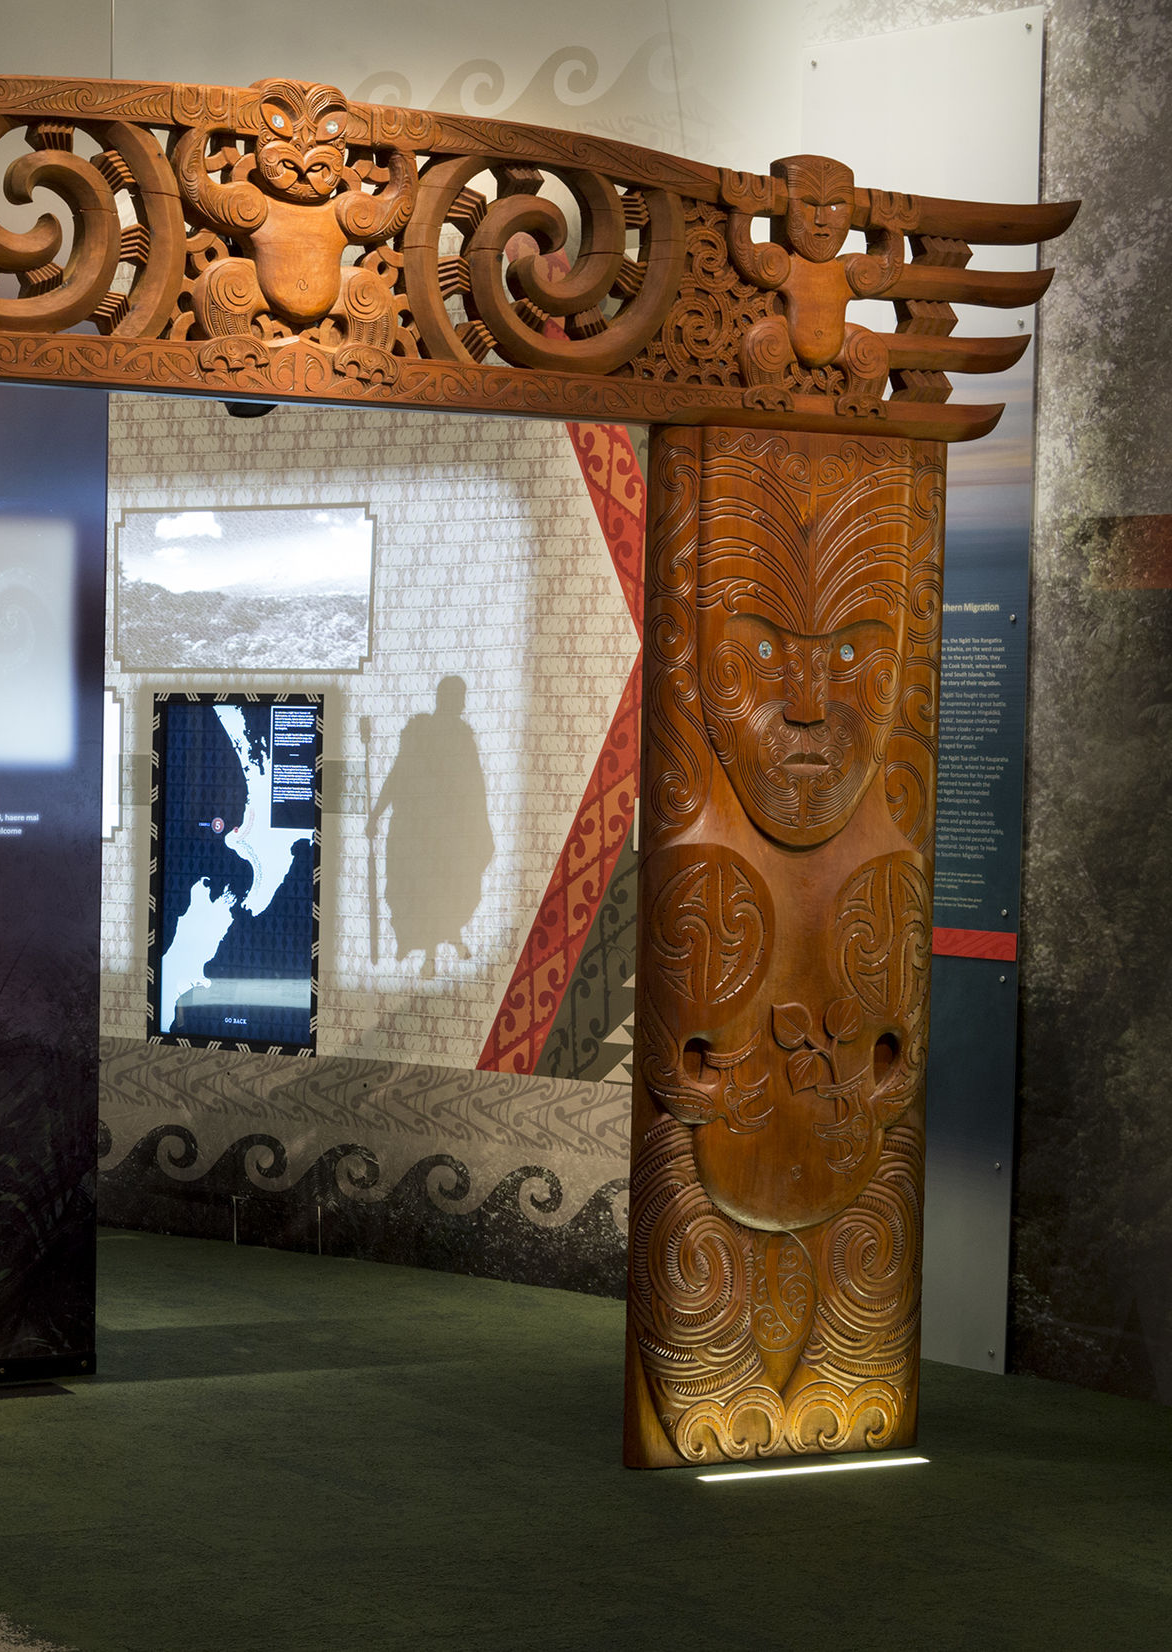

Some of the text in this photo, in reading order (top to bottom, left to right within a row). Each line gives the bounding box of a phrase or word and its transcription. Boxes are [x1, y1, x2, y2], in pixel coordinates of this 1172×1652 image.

[943, 603, 999, 613] thern Migration
[215, 821, 221, 830] 5
